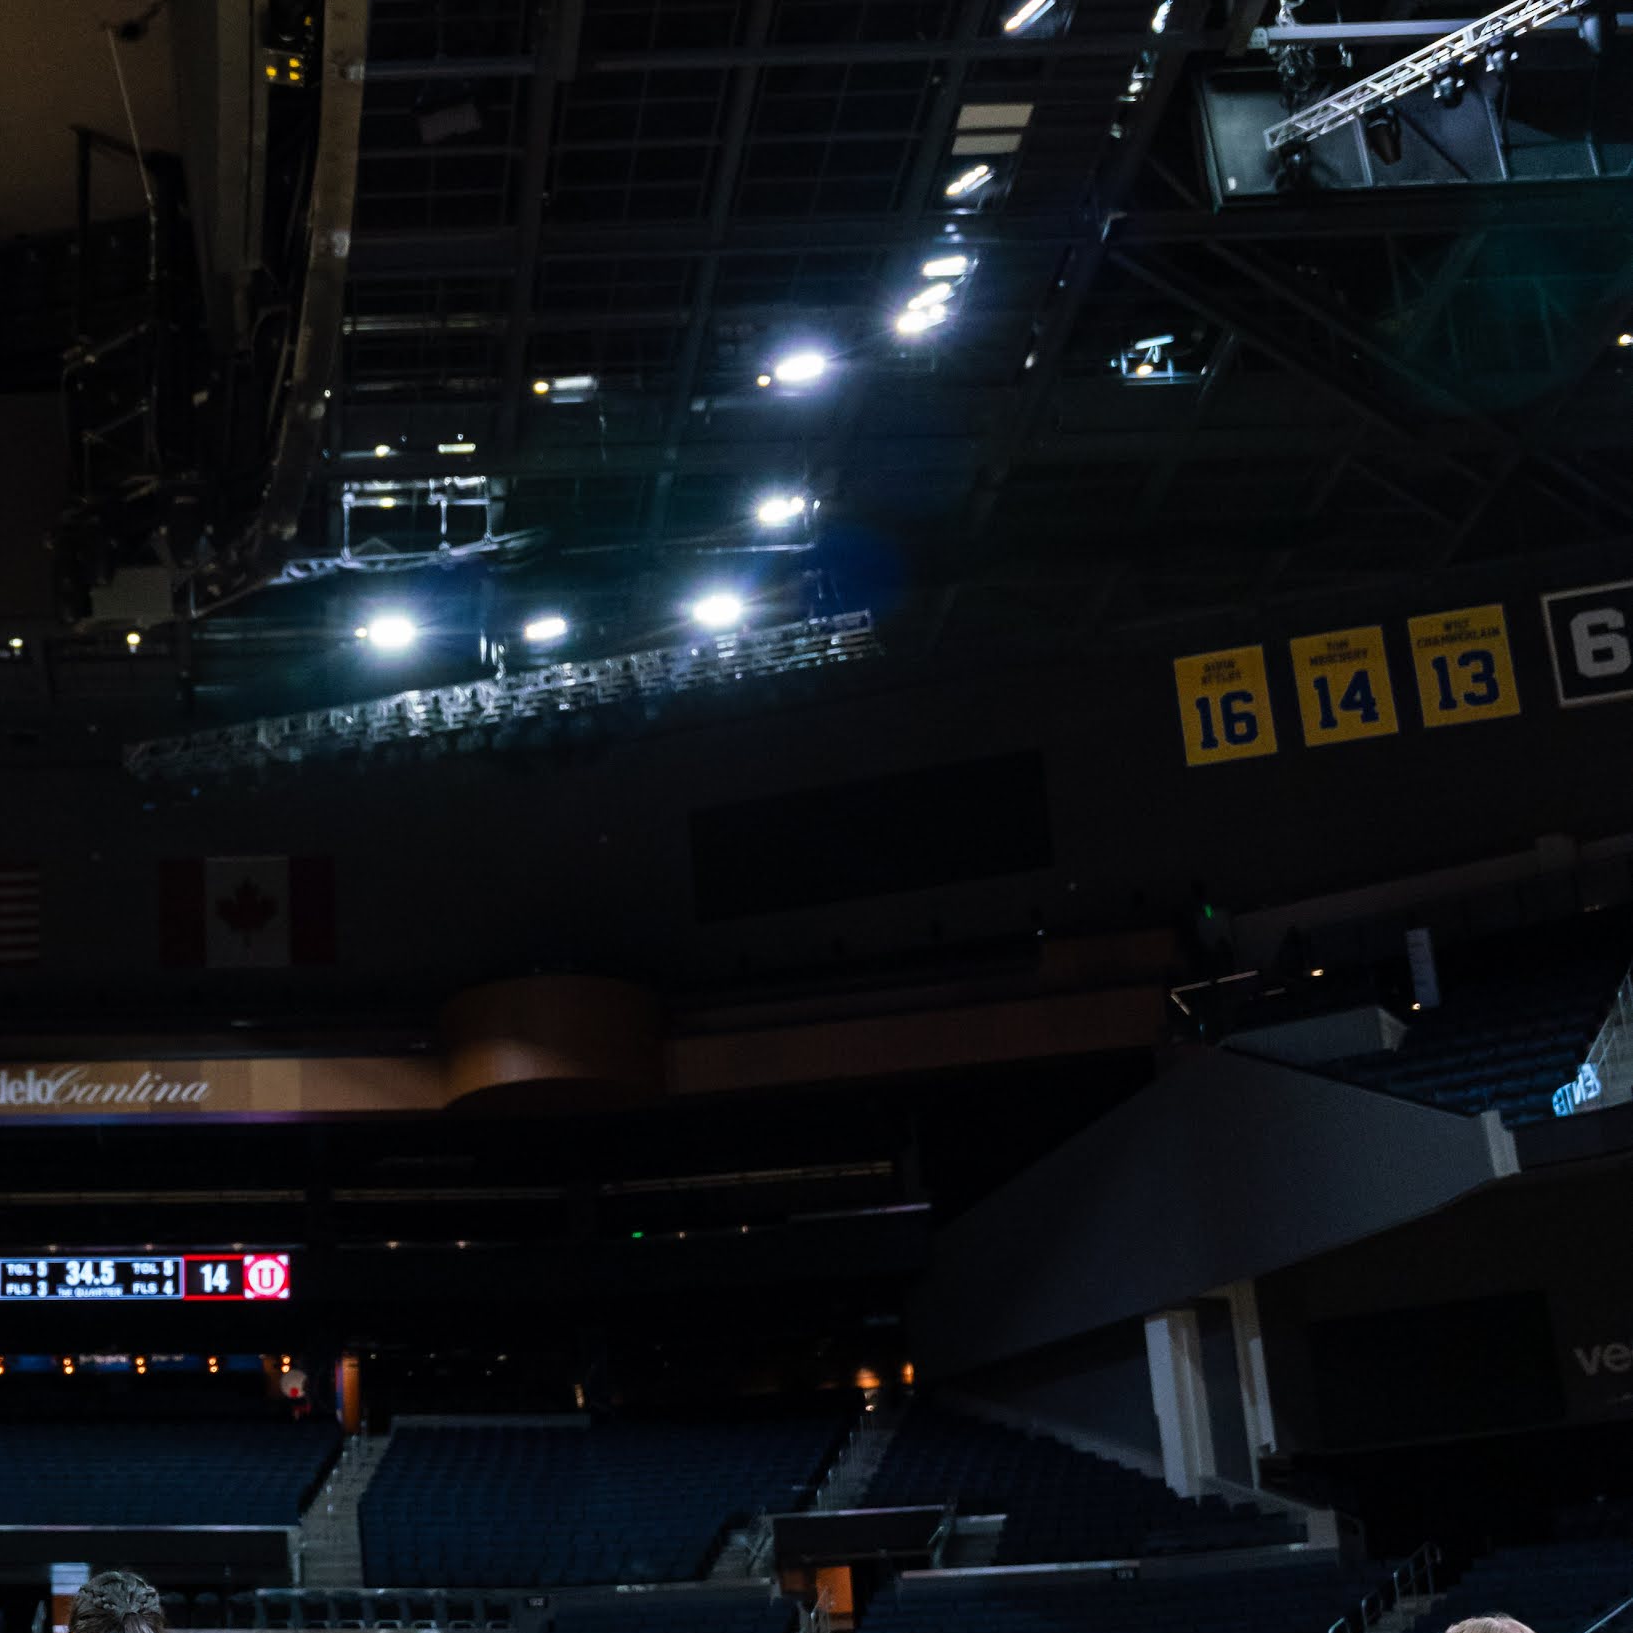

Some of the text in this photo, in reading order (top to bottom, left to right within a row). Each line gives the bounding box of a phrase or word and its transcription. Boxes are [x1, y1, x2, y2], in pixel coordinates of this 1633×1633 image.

[1569, 607, 1633, 679] 6
[1313, 670, 1380, 730] 14
[1431, 649, 1501, 712] 13
[1195, 691, 1260, 751] 16
[50, 1067, 209, 1106] Cantina
[65, 1260, 116, 1286] 34.5
[200, 1264, 230, 1293] 14
[259, 1267, 276, 1291] U
[1572, 1342, 1633, 1376] ve
